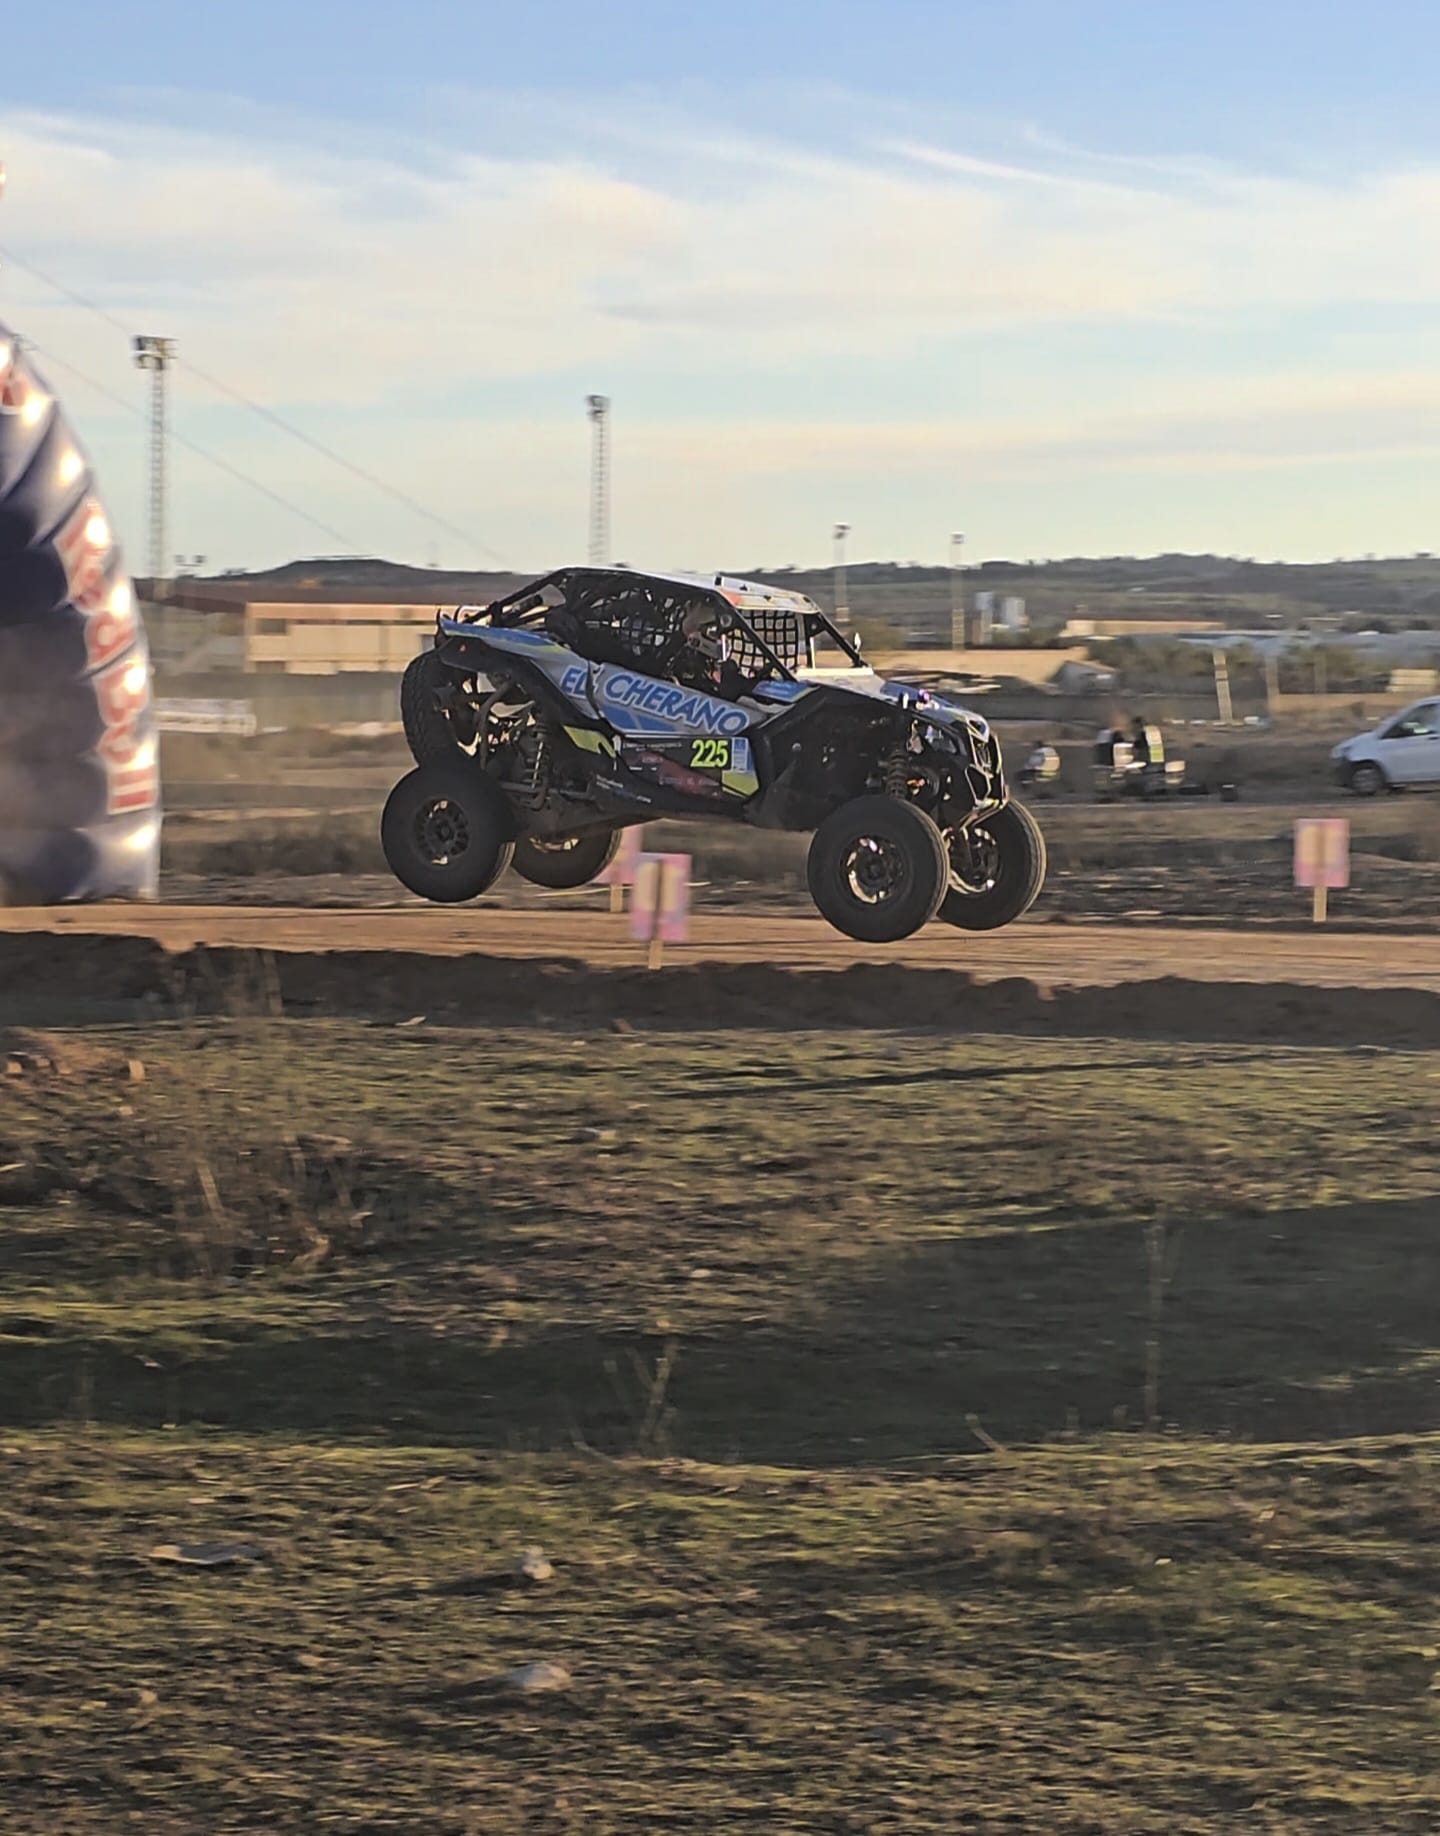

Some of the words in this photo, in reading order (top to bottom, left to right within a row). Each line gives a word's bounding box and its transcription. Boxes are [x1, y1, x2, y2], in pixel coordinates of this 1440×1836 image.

[561, 666, 597, 698] EL
[604, 673, 749, 734] CHERANO
[691, 739, 728, 768] 225
